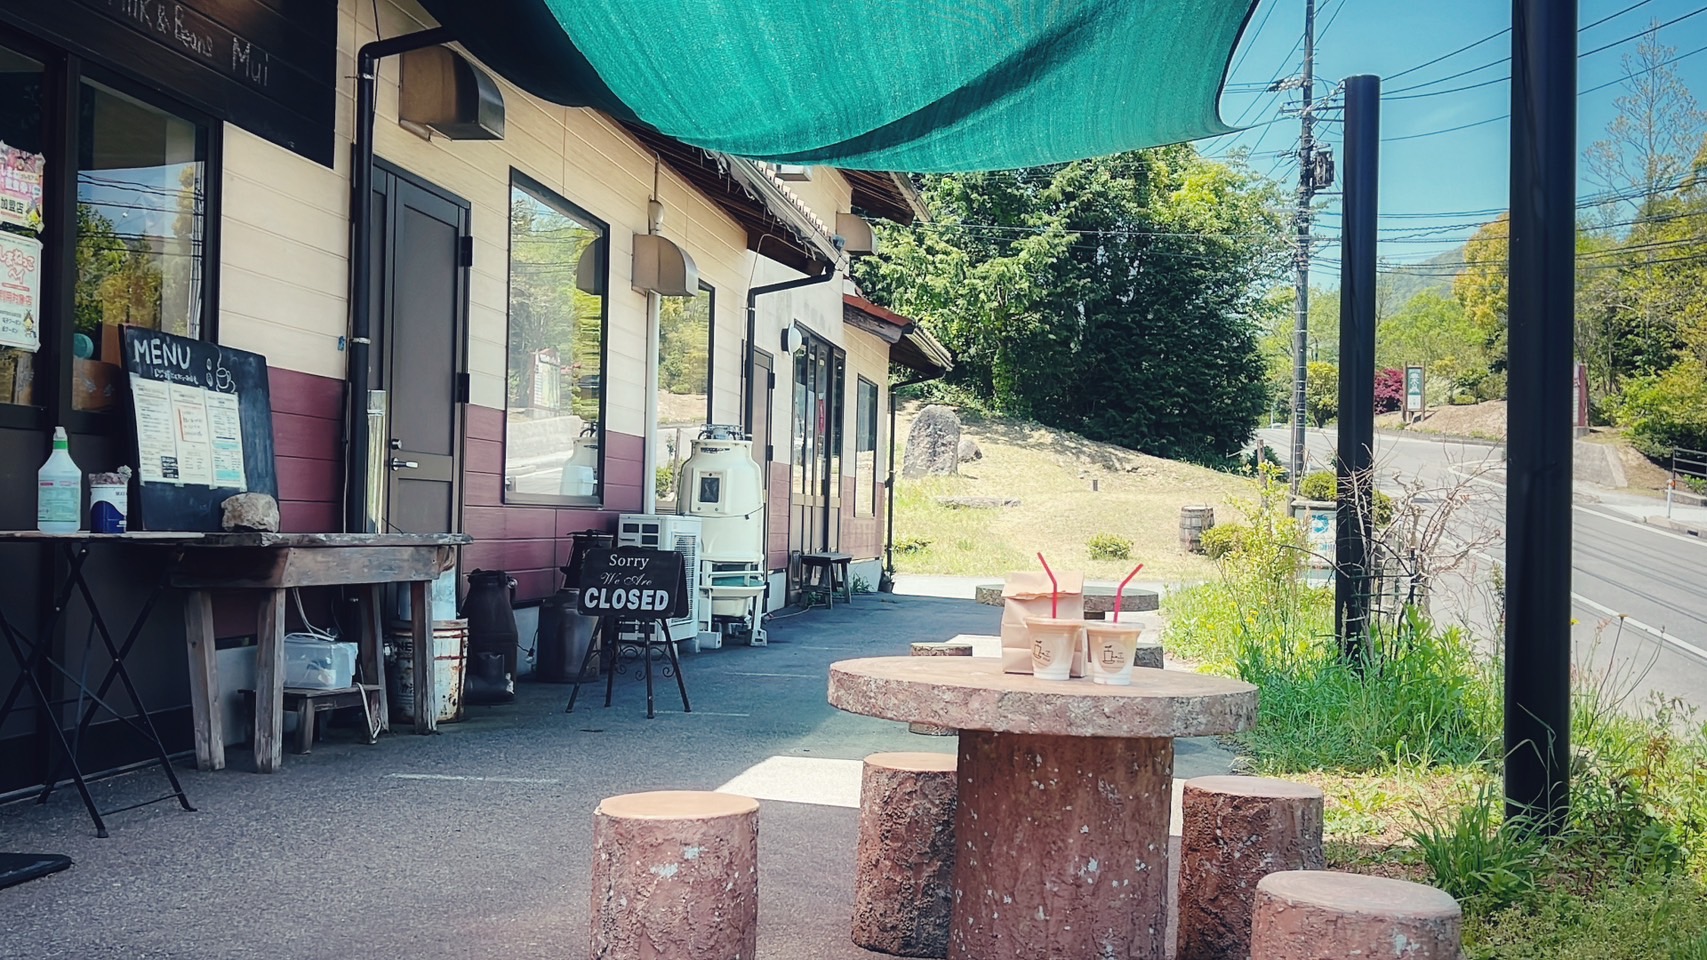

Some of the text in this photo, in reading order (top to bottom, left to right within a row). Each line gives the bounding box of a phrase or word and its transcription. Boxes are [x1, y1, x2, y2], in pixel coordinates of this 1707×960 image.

[156, 4, 171, 34] &
[174, 5, 213, 57] Beans
[232, 36, 269, 86] Mui
[1, 198, 24, 215] 加盟店
[134, 338, 191, 369] MENU
[609, 553, 650, 570] Sorry
[600, 572, 653, 586] We Are
[584, 587, 669, 611] CLOSED
